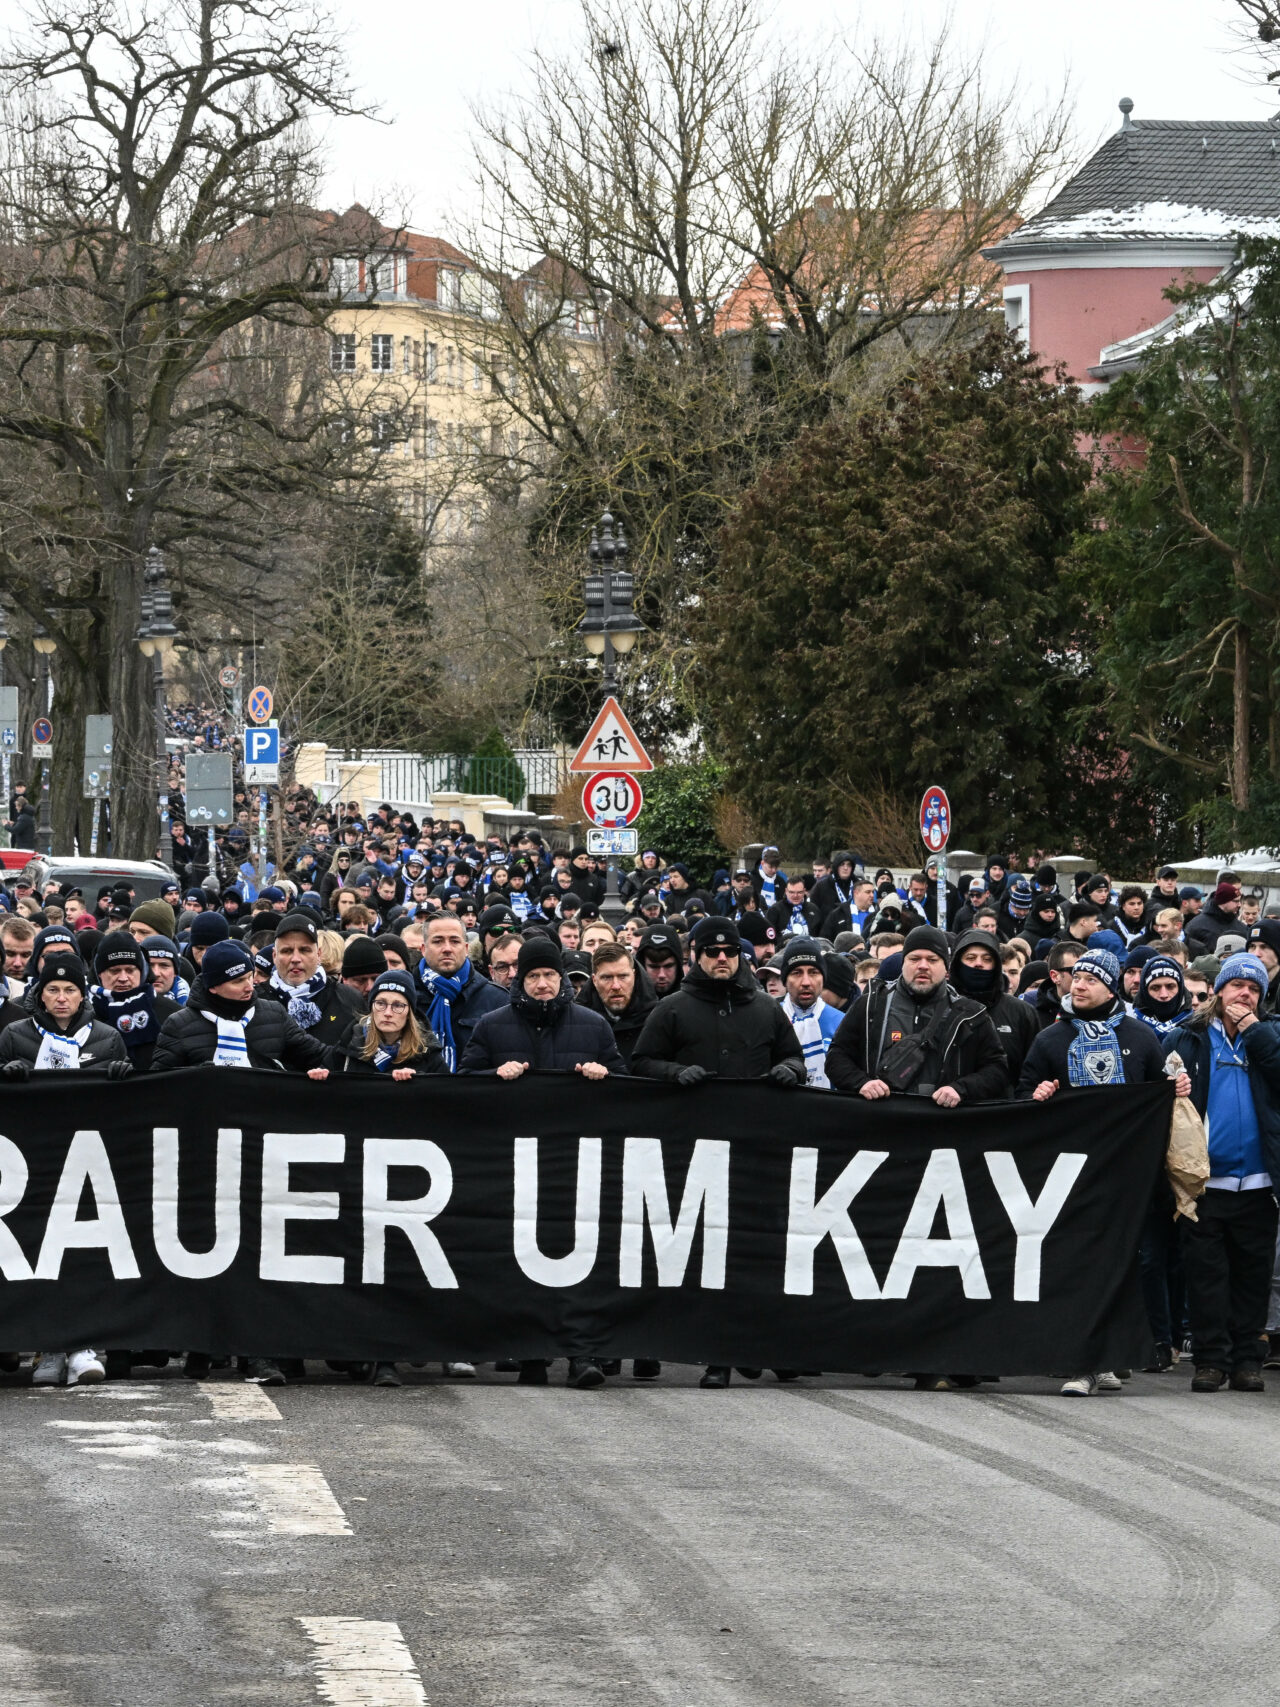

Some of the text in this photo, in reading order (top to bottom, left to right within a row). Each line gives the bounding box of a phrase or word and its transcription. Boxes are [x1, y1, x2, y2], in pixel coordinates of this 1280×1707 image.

[222, 671, 236, 682] 50
[252, 732, 271, 760] P
[596, 786, 629, 811] 30
[514, 1137, 730, 1289] UM
[784, 1147, 1087, 1301] KAY
